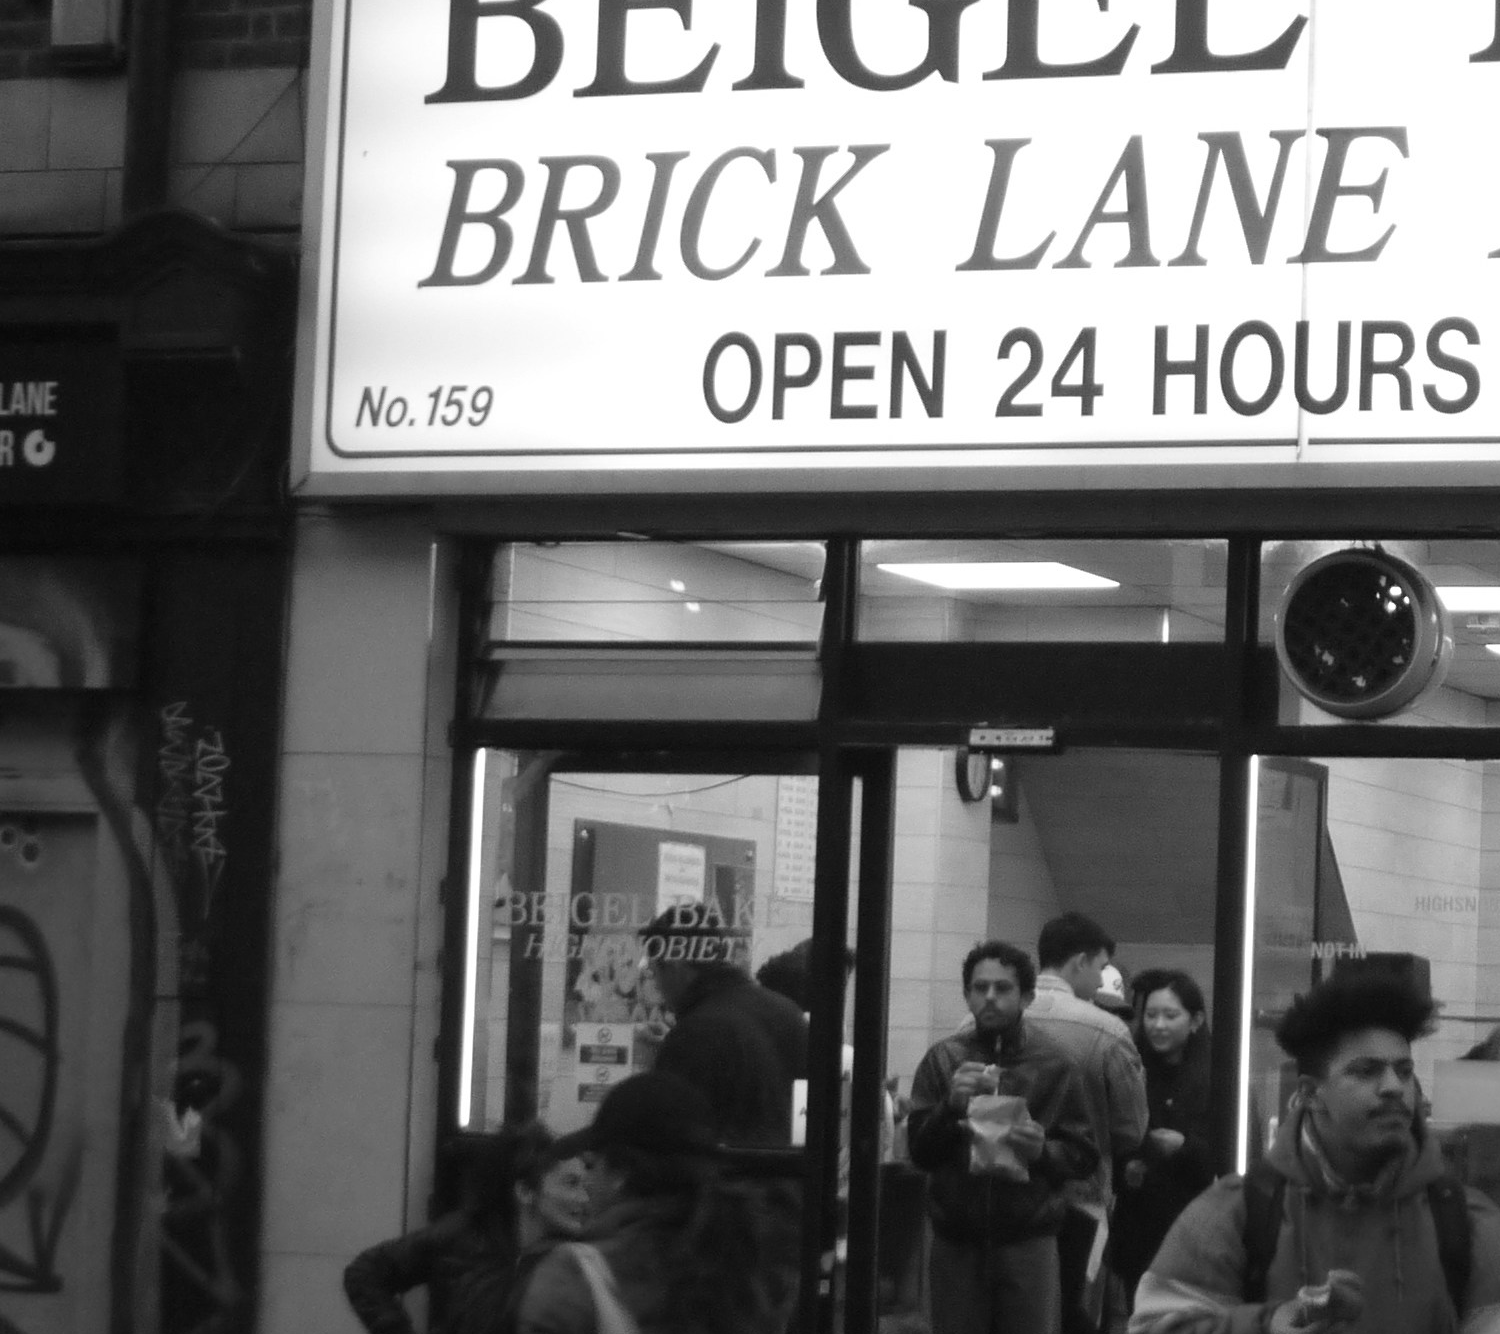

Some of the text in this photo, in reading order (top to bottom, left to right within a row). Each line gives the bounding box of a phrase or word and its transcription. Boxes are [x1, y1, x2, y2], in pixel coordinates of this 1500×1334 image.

[417, 144, 890, 289] BRICK
[955, 126, 1409, 272] LANE
[355, 385, 494, 428] No.159
[702, 330, 947, 424] OPEN
[994, 327, 1104, 418] 24
[1152, 316, 1481, 417] HOURS
[507, 890, 785, 931] BEGEL BAK
